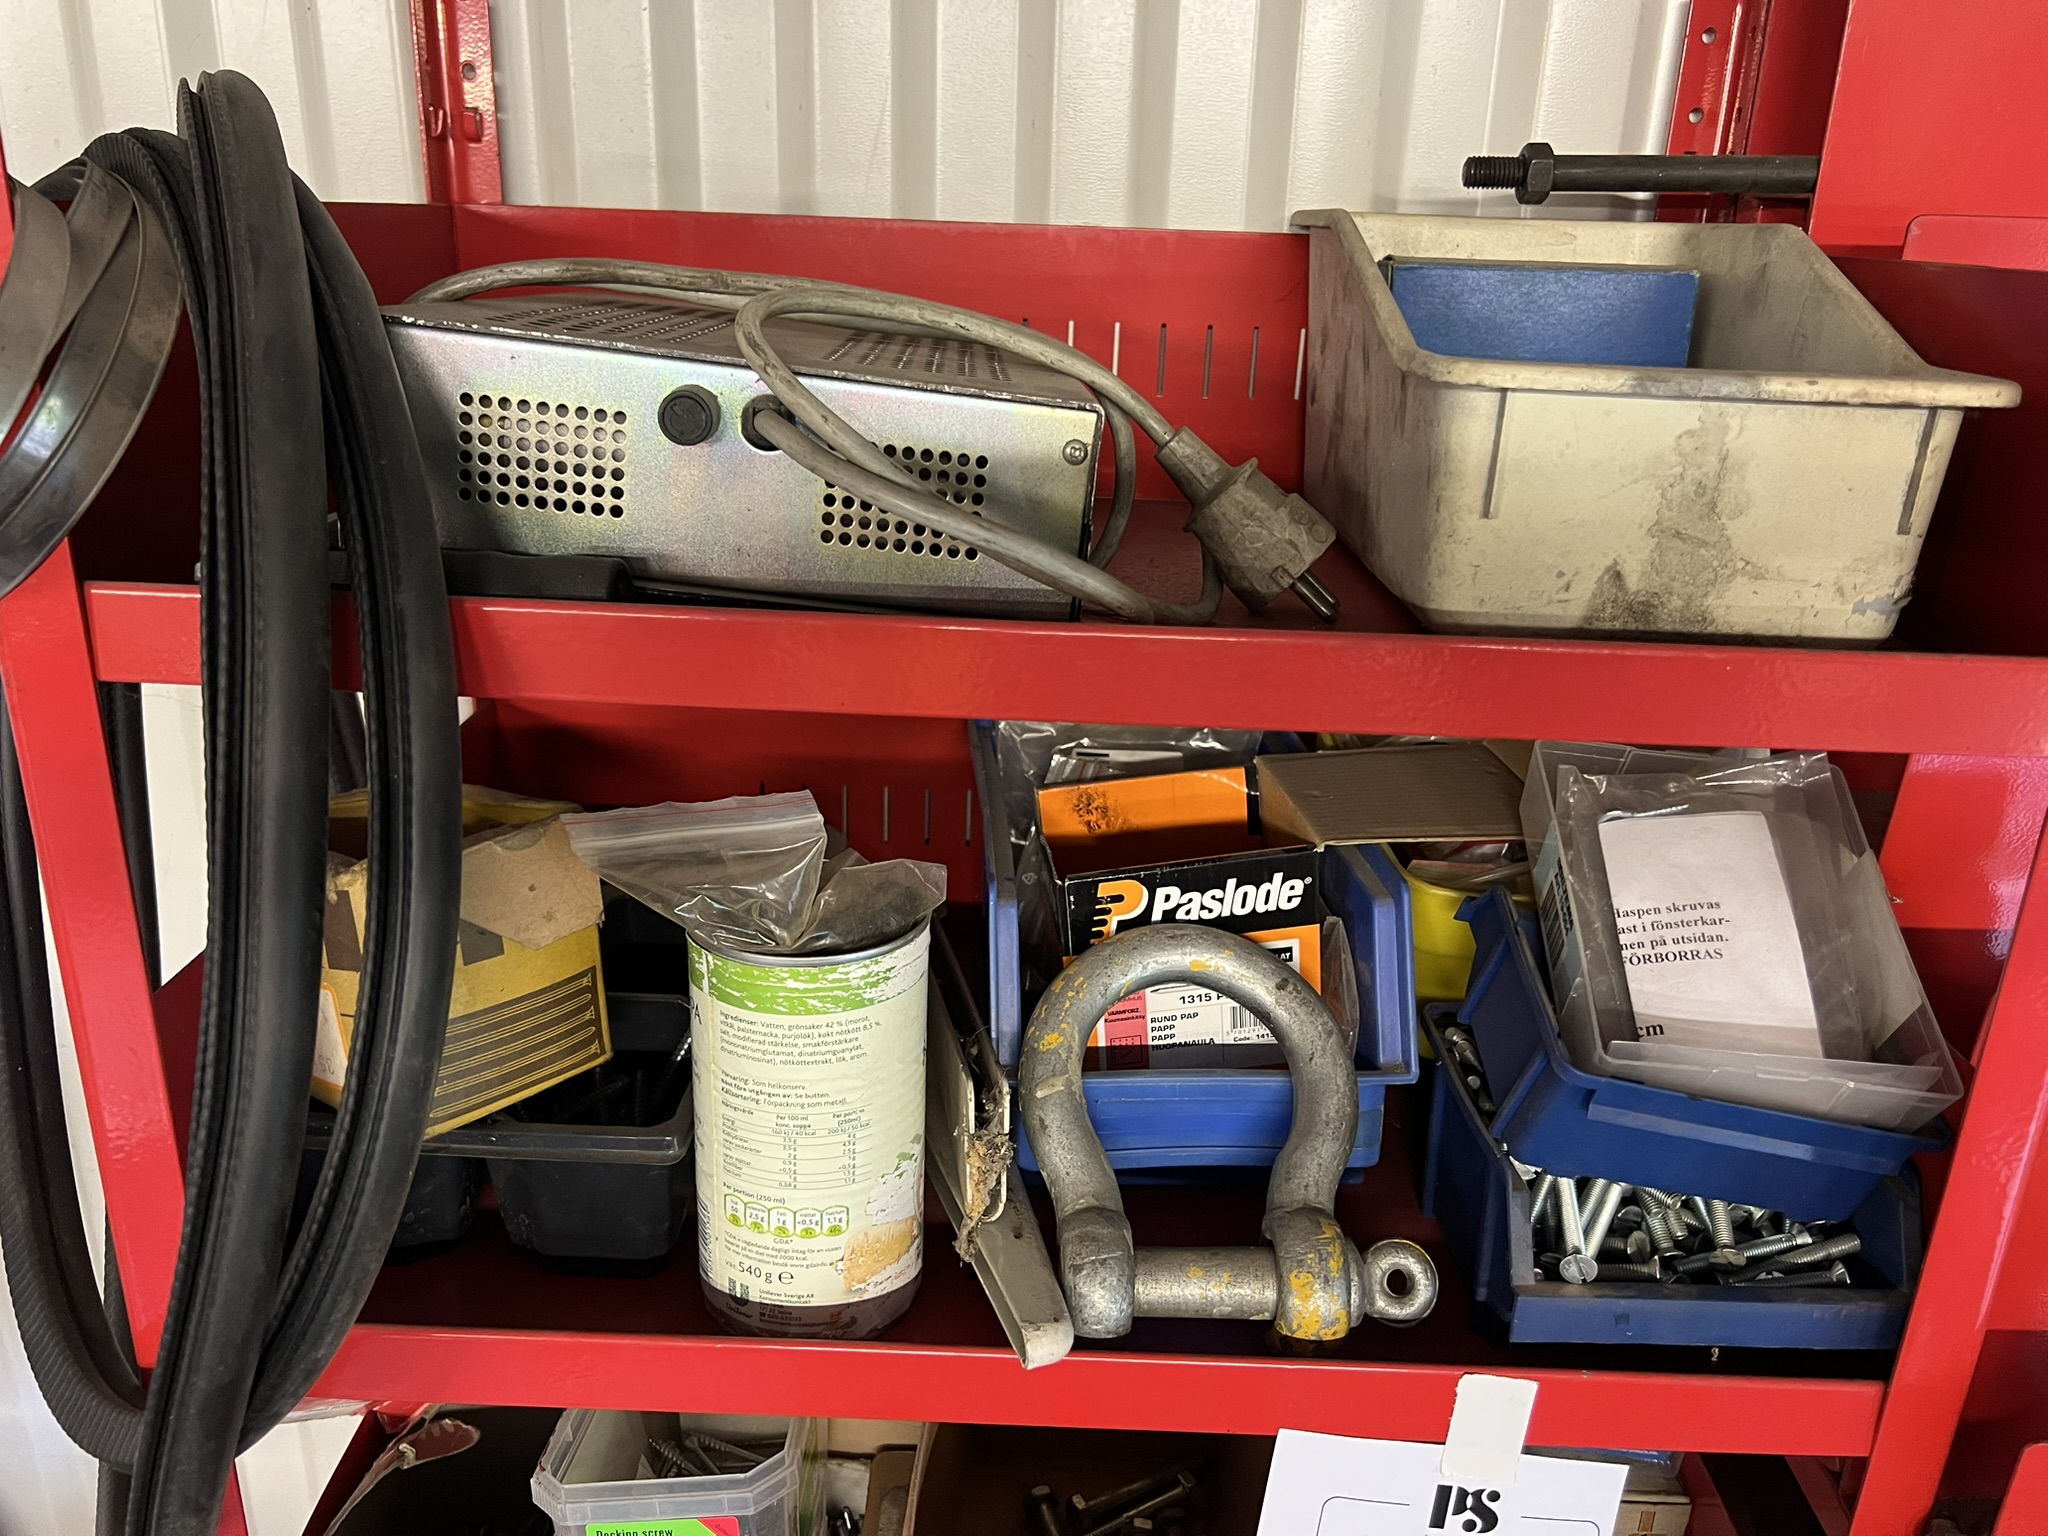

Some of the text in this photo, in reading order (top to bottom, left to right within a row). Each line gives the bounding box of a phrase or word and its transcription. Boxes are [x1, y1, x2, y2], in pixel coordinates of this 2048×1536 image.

[1665, 901, 1721, 914] skruvas
[1617, 915, 1730, 935] ast i fönsterkar-
[1650, 935, 1667, 950] på
[1672, 932, 1729, 946] utsidan.
[1180, 993, 1212, 1005] 1315
[720, 1010, 759, 1026] Ingredienser:
[760, 1021, 786, 1030] Vatten,
[788, 1023, 823, 1031] grönsaker
[845, 1016, 870, 1026] (morot,
[1151, 1012, 1198, 1023] RUND PAP
[737, 1027, 780, 1038] palsternacka,
[782, 1031, 816, 1040] purjolök),
[835, 1027, 861, 1036] nötkött
[863, 1023, 872, 1031] 8,5
[1151, 1024, 1175, 1032] PAPP
[732, 1033, 765, 1045] modifierad
[803, 1037, 859, 1047] smakförstärkare
[1152, 1034, 1175, 1042] PAPP
[798, 1044, 863, 1056] dinatriumguanylat,
[1152, 1038, 1215, 1051] HUOPANAULA
[752, 1079, 766, 1087] Som
[768, 1082, 807, 1090] helkonserv.
[764, 1098, 805, 1109] Förpackning
[733, 1187, 755, 1199] portion
[756, 1193, 771, 1202] (250
[773, 1197, 785, 1205] ml)
[749, 1212, 758, 1220] 2,5
[738, 1261, 762, 1278] 540
[765, 1272, 773, 1284] g
[759, 1289, 782, 1297] Unilever
